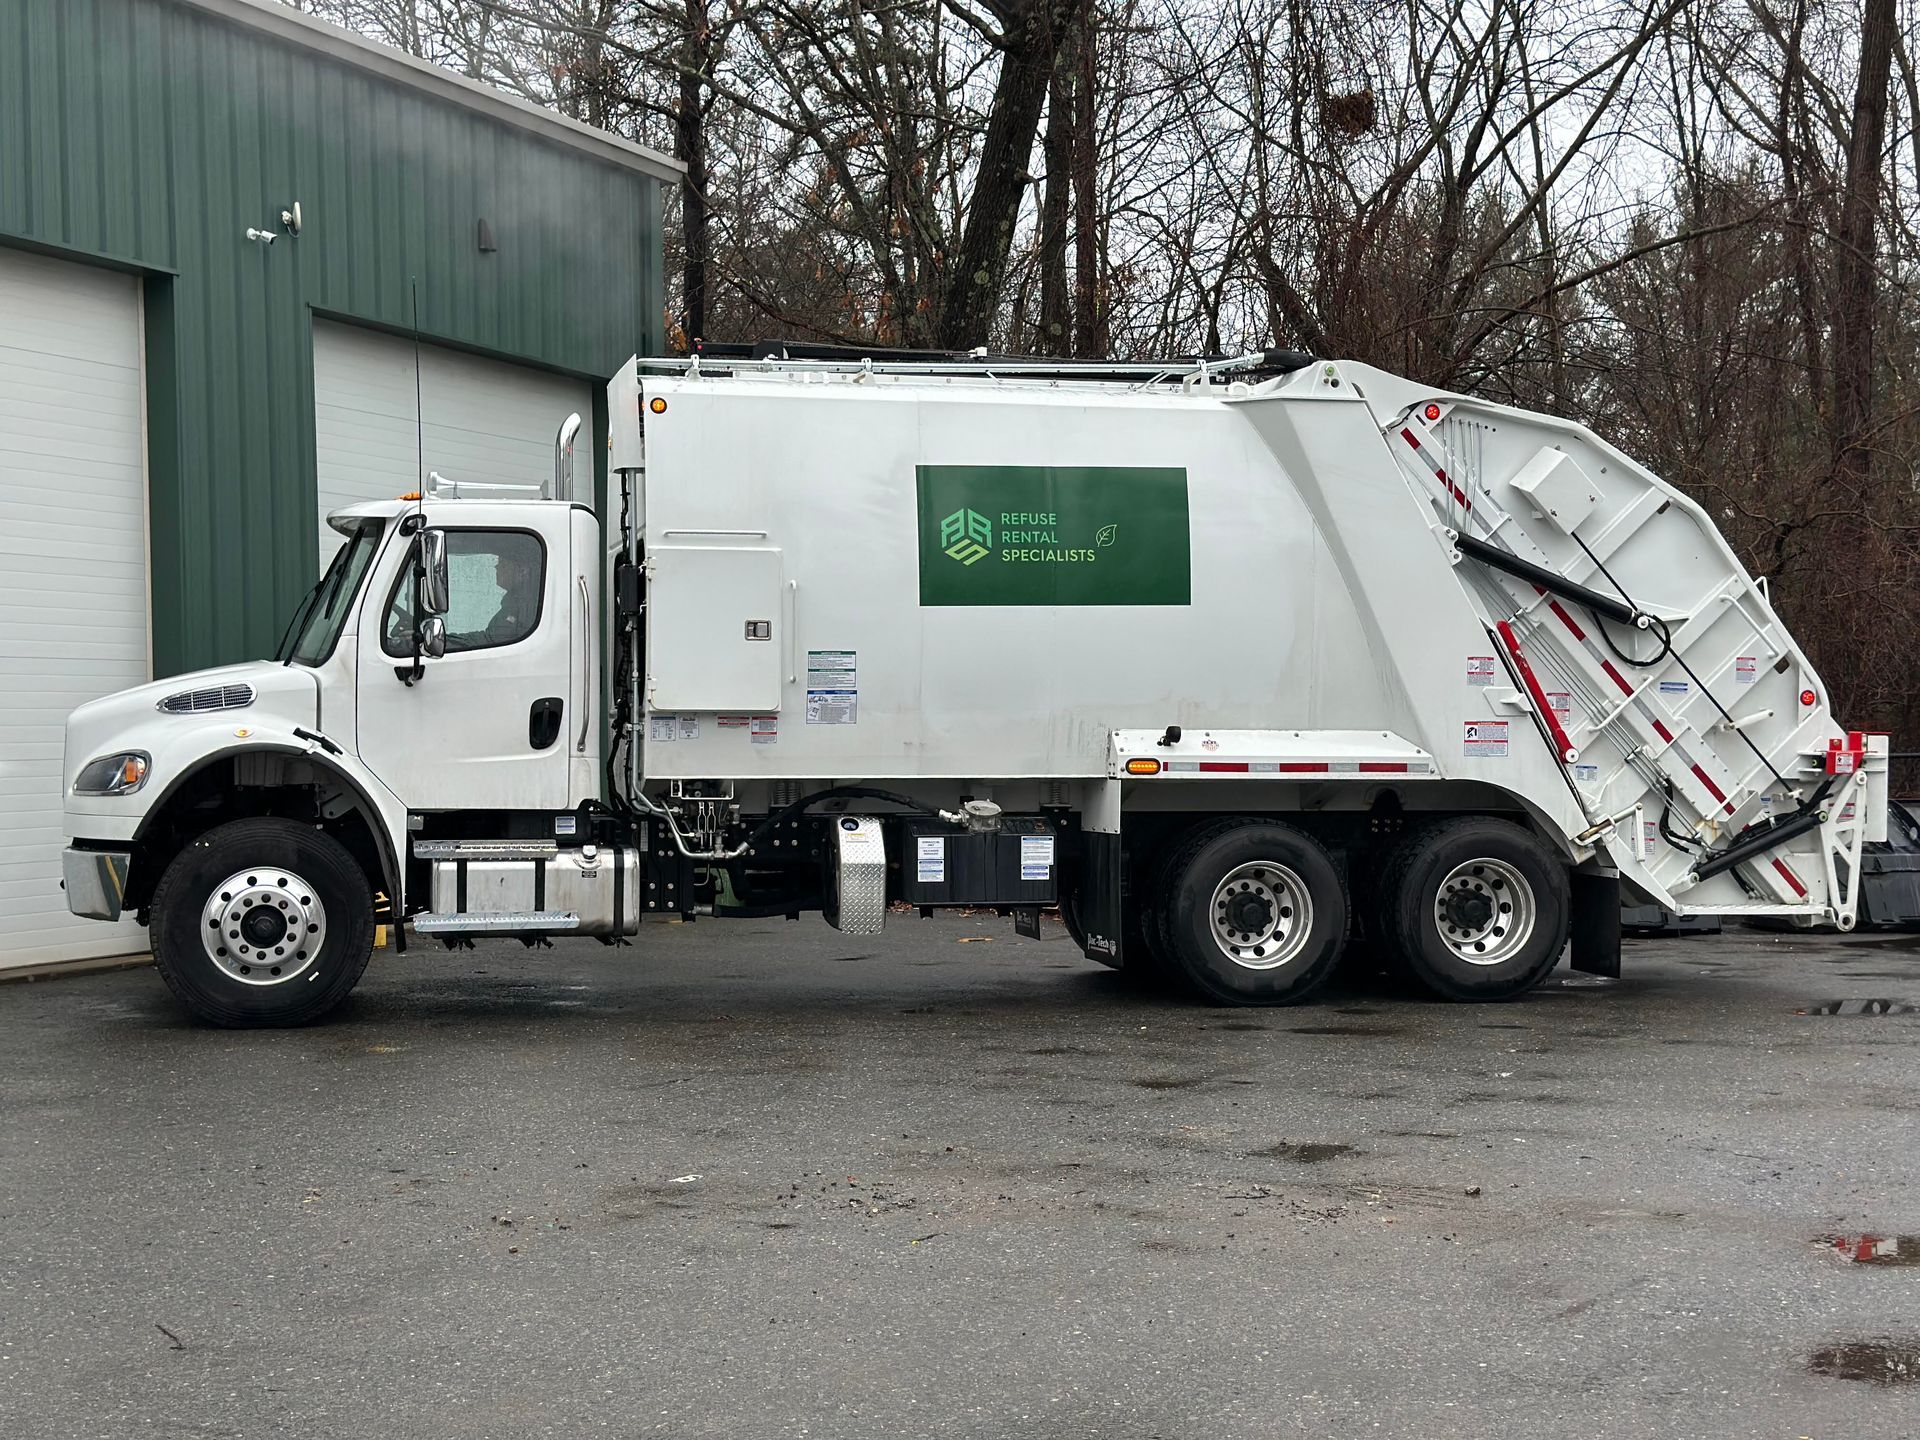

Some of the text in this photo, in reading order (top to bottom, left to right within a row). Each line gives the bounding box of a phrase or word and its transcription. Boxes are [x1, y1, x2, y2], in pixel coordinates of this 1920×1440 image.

[1001, 512, 1057, 525] REFUSE
[1001, 531, 1059, 544] RENTAL
[1001, 549, 1096, 562] SPECIALISTS
